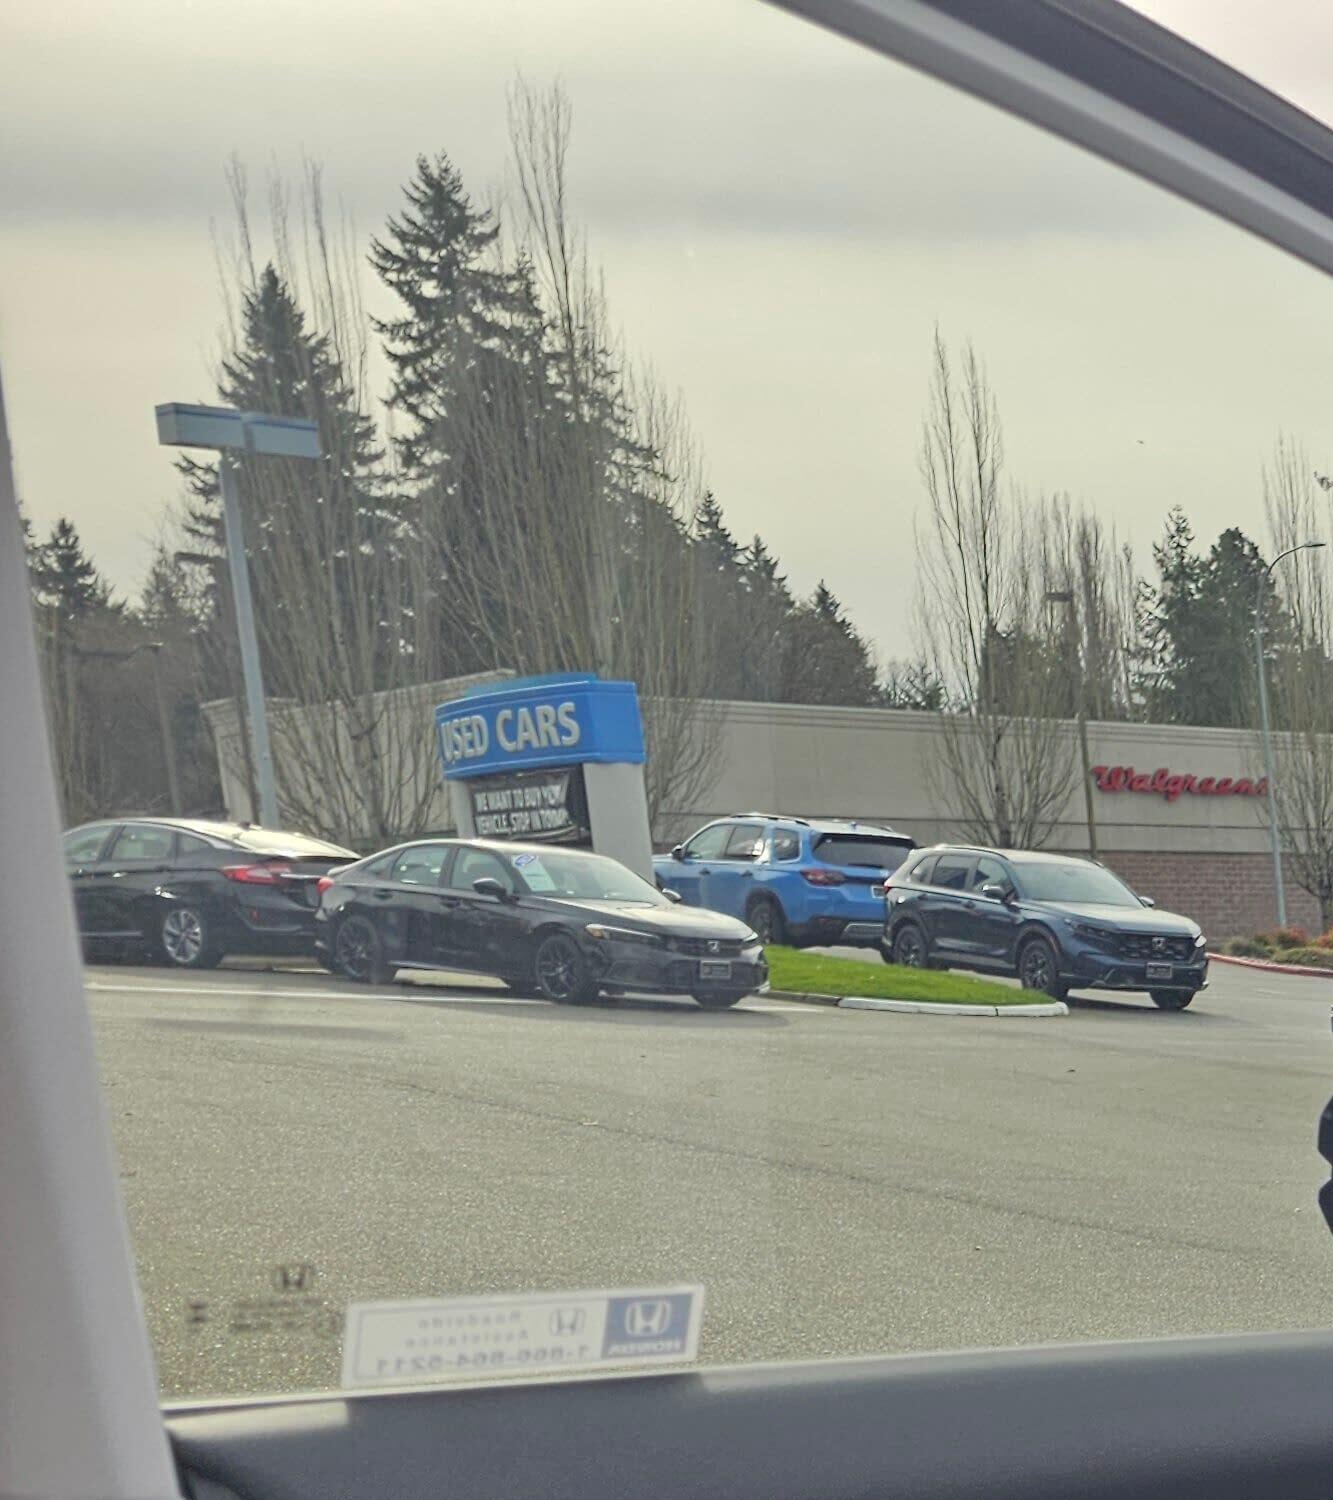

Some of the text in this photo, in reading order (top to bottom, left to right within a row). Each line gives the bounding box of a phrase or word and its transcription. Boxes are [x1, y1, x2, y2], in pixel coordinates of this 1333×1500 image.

[441, 702, 580, 762] USED CARS
[474, 792, 488, 812] WE
[488, 789, 512, 810] WANT
[512, 788, 523, 808] TO
[524, 786, 542, 808] BUY
[1092, 765, 1269, 803] Walgreens
[510, 811, 530, 832] STOP
[530, 810, 541, 831] IN
